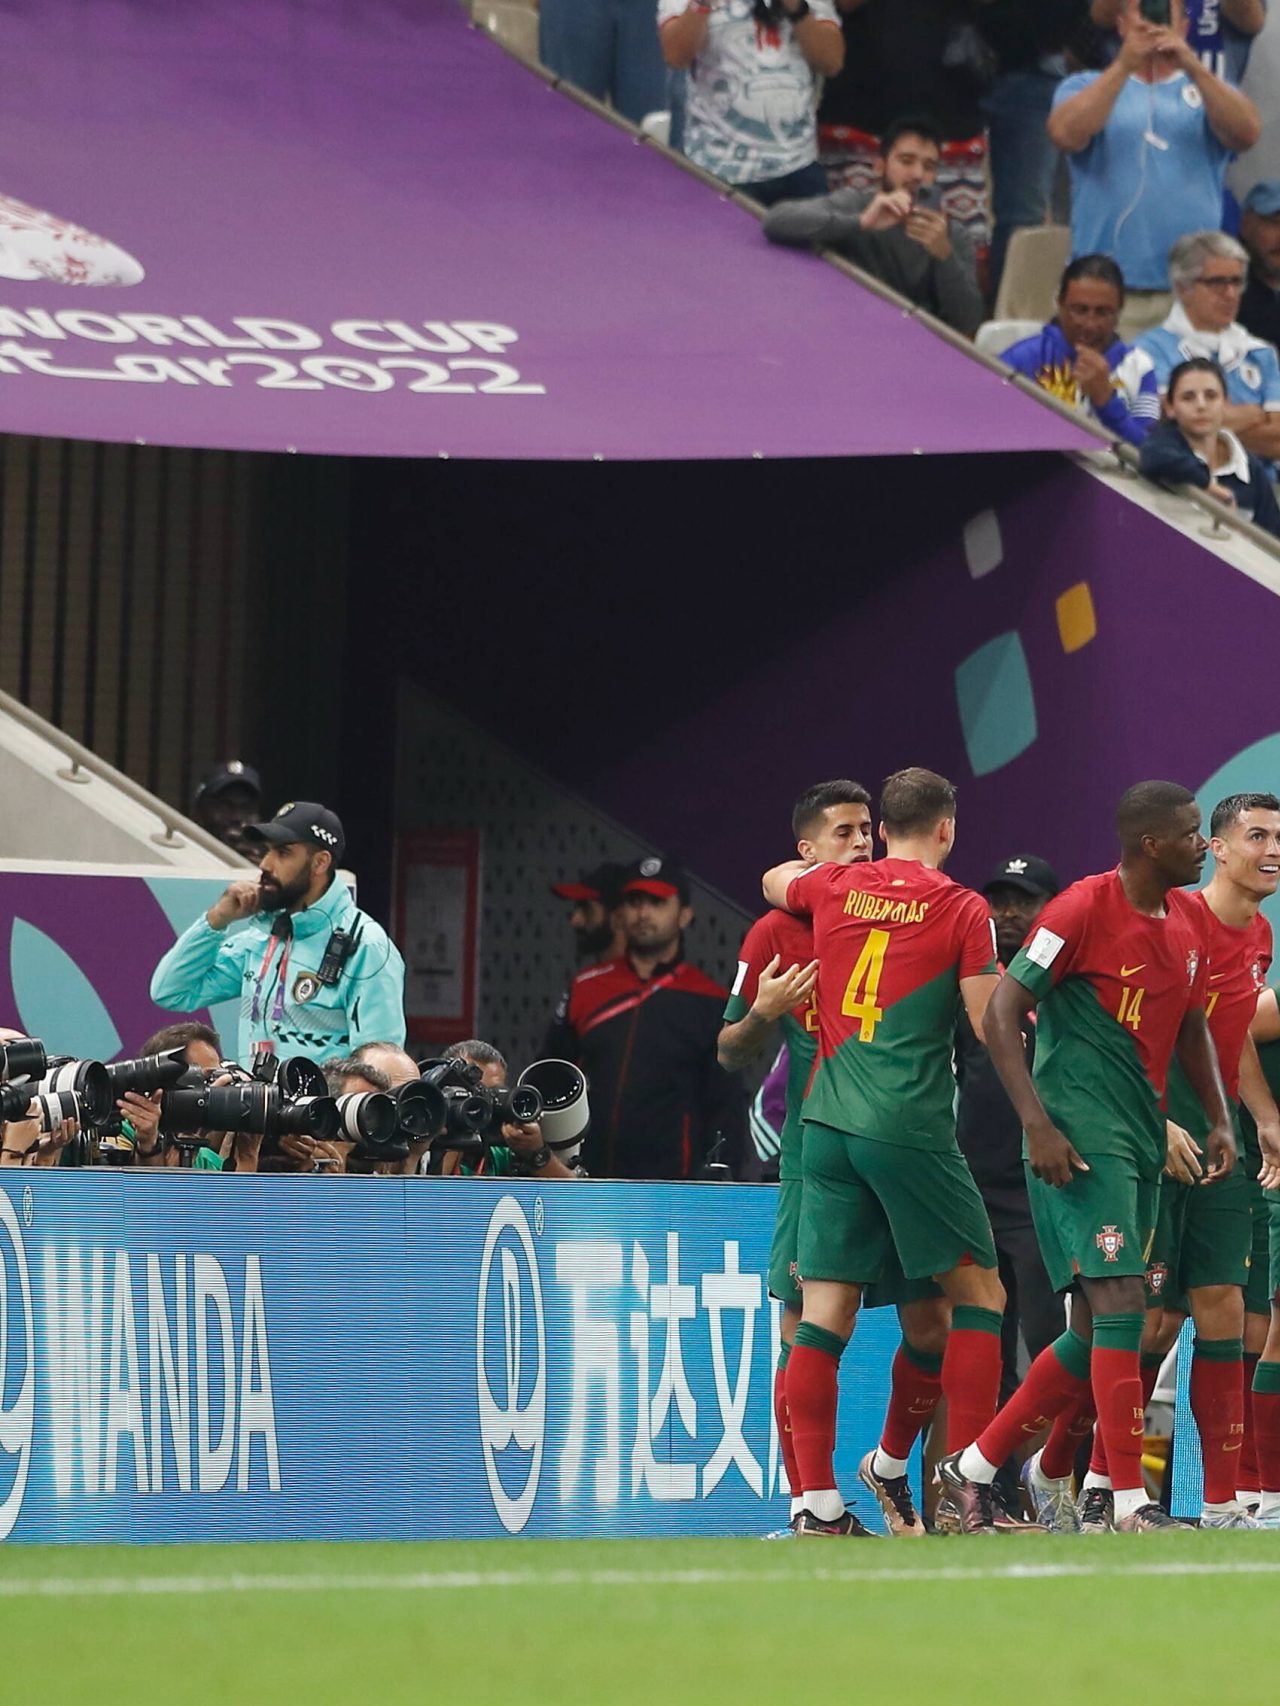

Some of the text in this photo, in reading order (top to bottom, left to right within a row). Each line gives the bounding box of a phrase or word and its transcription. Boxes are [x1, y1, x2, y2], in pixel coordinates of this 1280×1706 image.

[331, 319, 518, 353] CUP
[841, 928, 891, 1043] 4
[1116, 987, 1145, 1030] 14
[43, 1246, 283, 1497] WANDA
